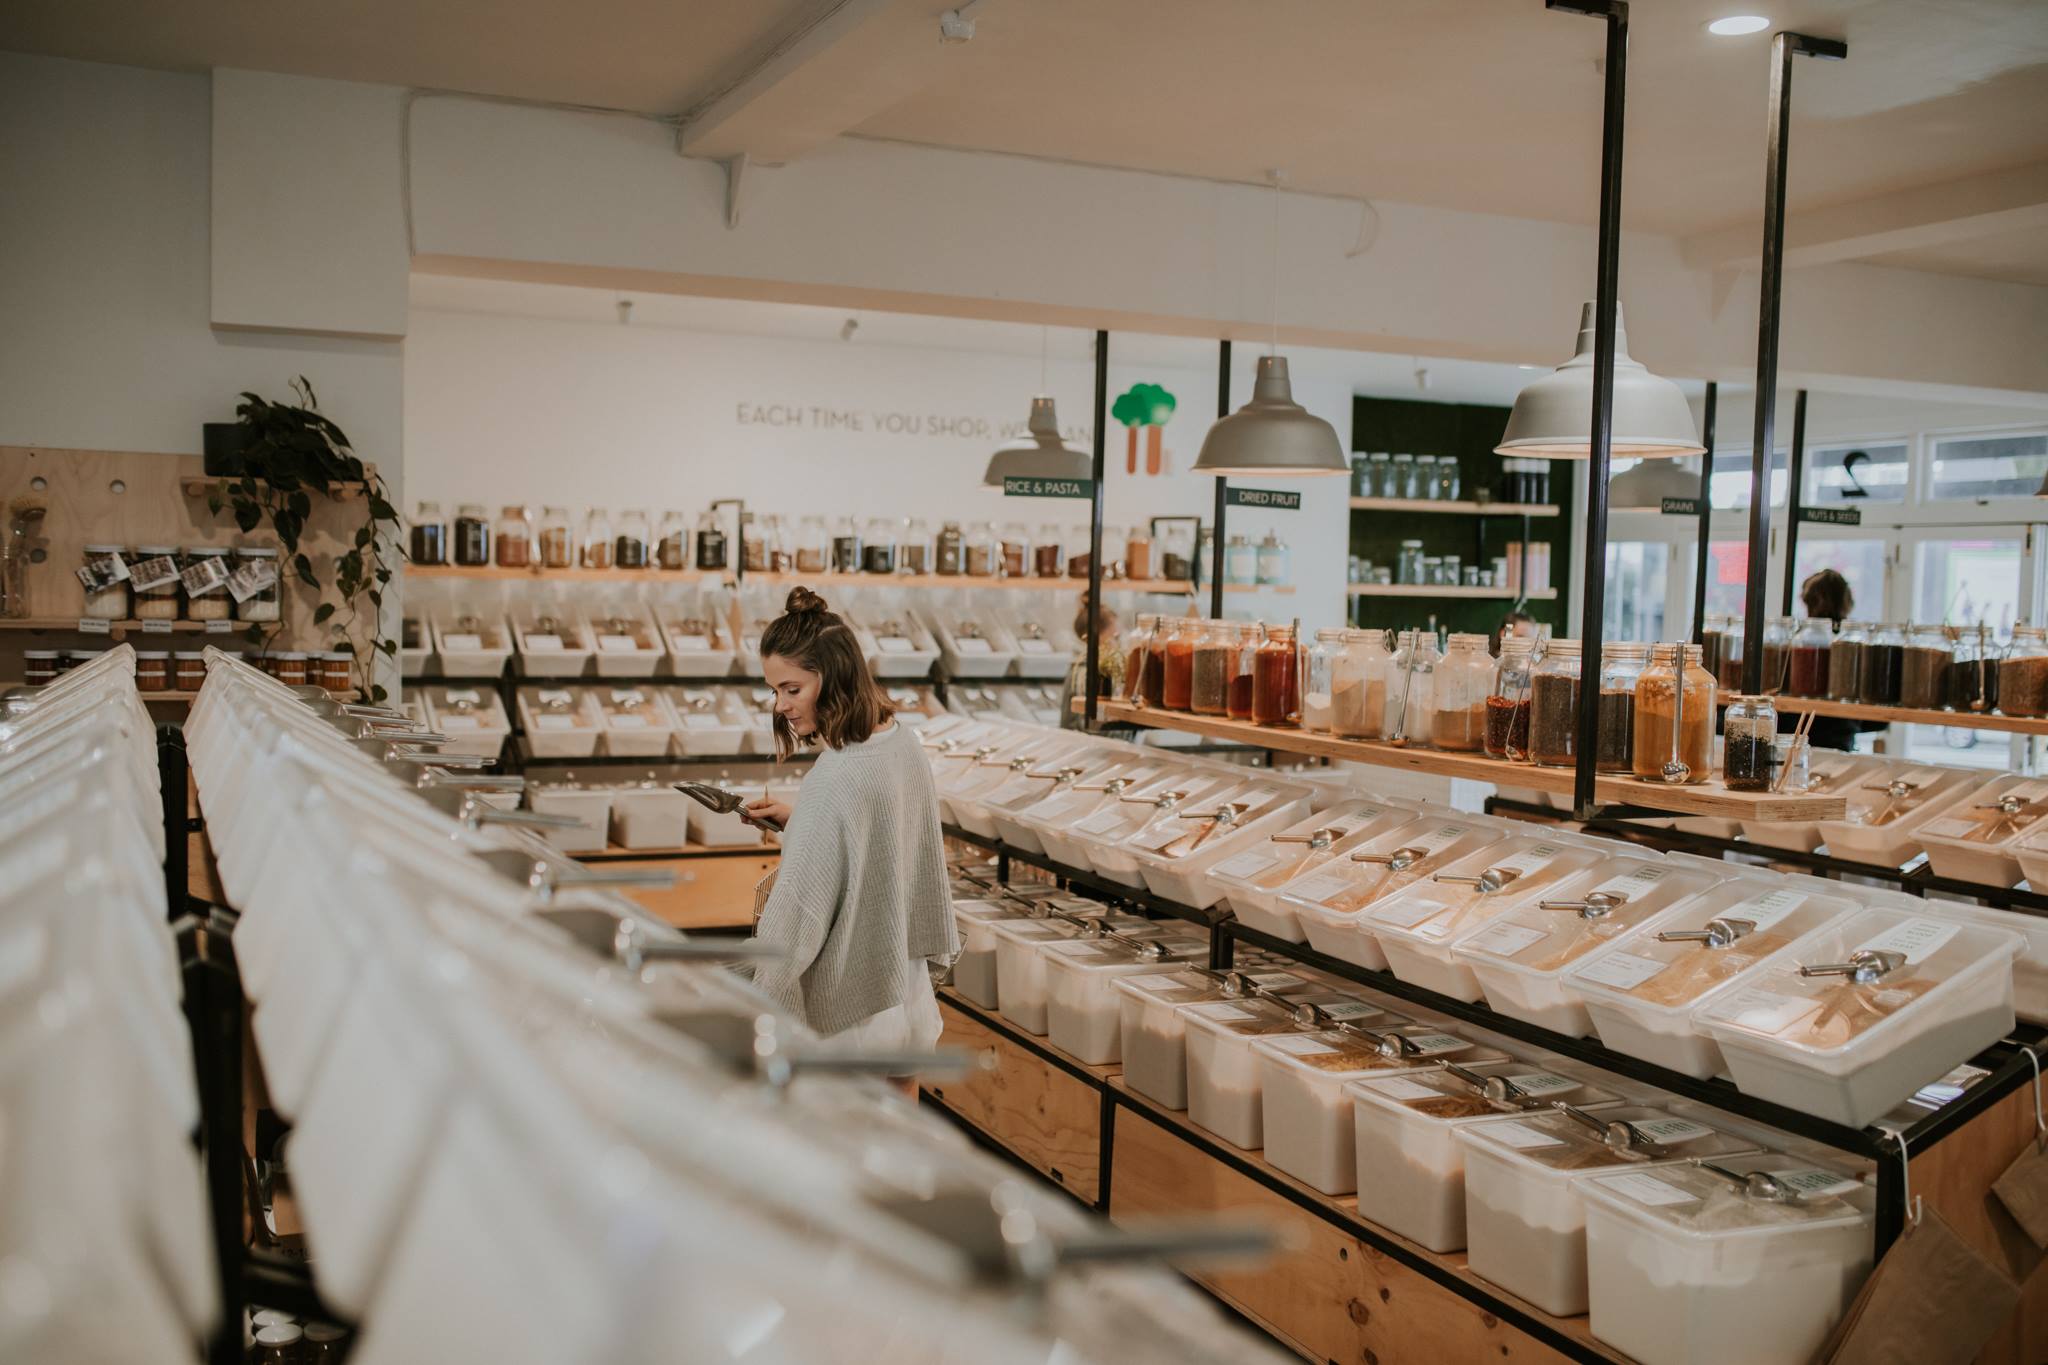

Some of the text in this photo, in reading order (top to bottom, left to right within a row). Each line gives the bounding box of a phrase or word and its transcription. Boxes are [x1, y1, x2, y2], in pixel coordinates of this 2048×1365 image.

[735, 402, 803, 428] EACH
[808, 405, 864, 432] TIME
[871, 411, 921, 434] YOU
[1005, 480, 1080, 495] RICE & PASTA
[1239, 490, 1299, 506] DRIED FRUIT
[1663, 500, 1694, 513] GRAINS
[1807, 509, 1827, 521] NUTS
[1837, 511, 1858, 523] SEEDS
